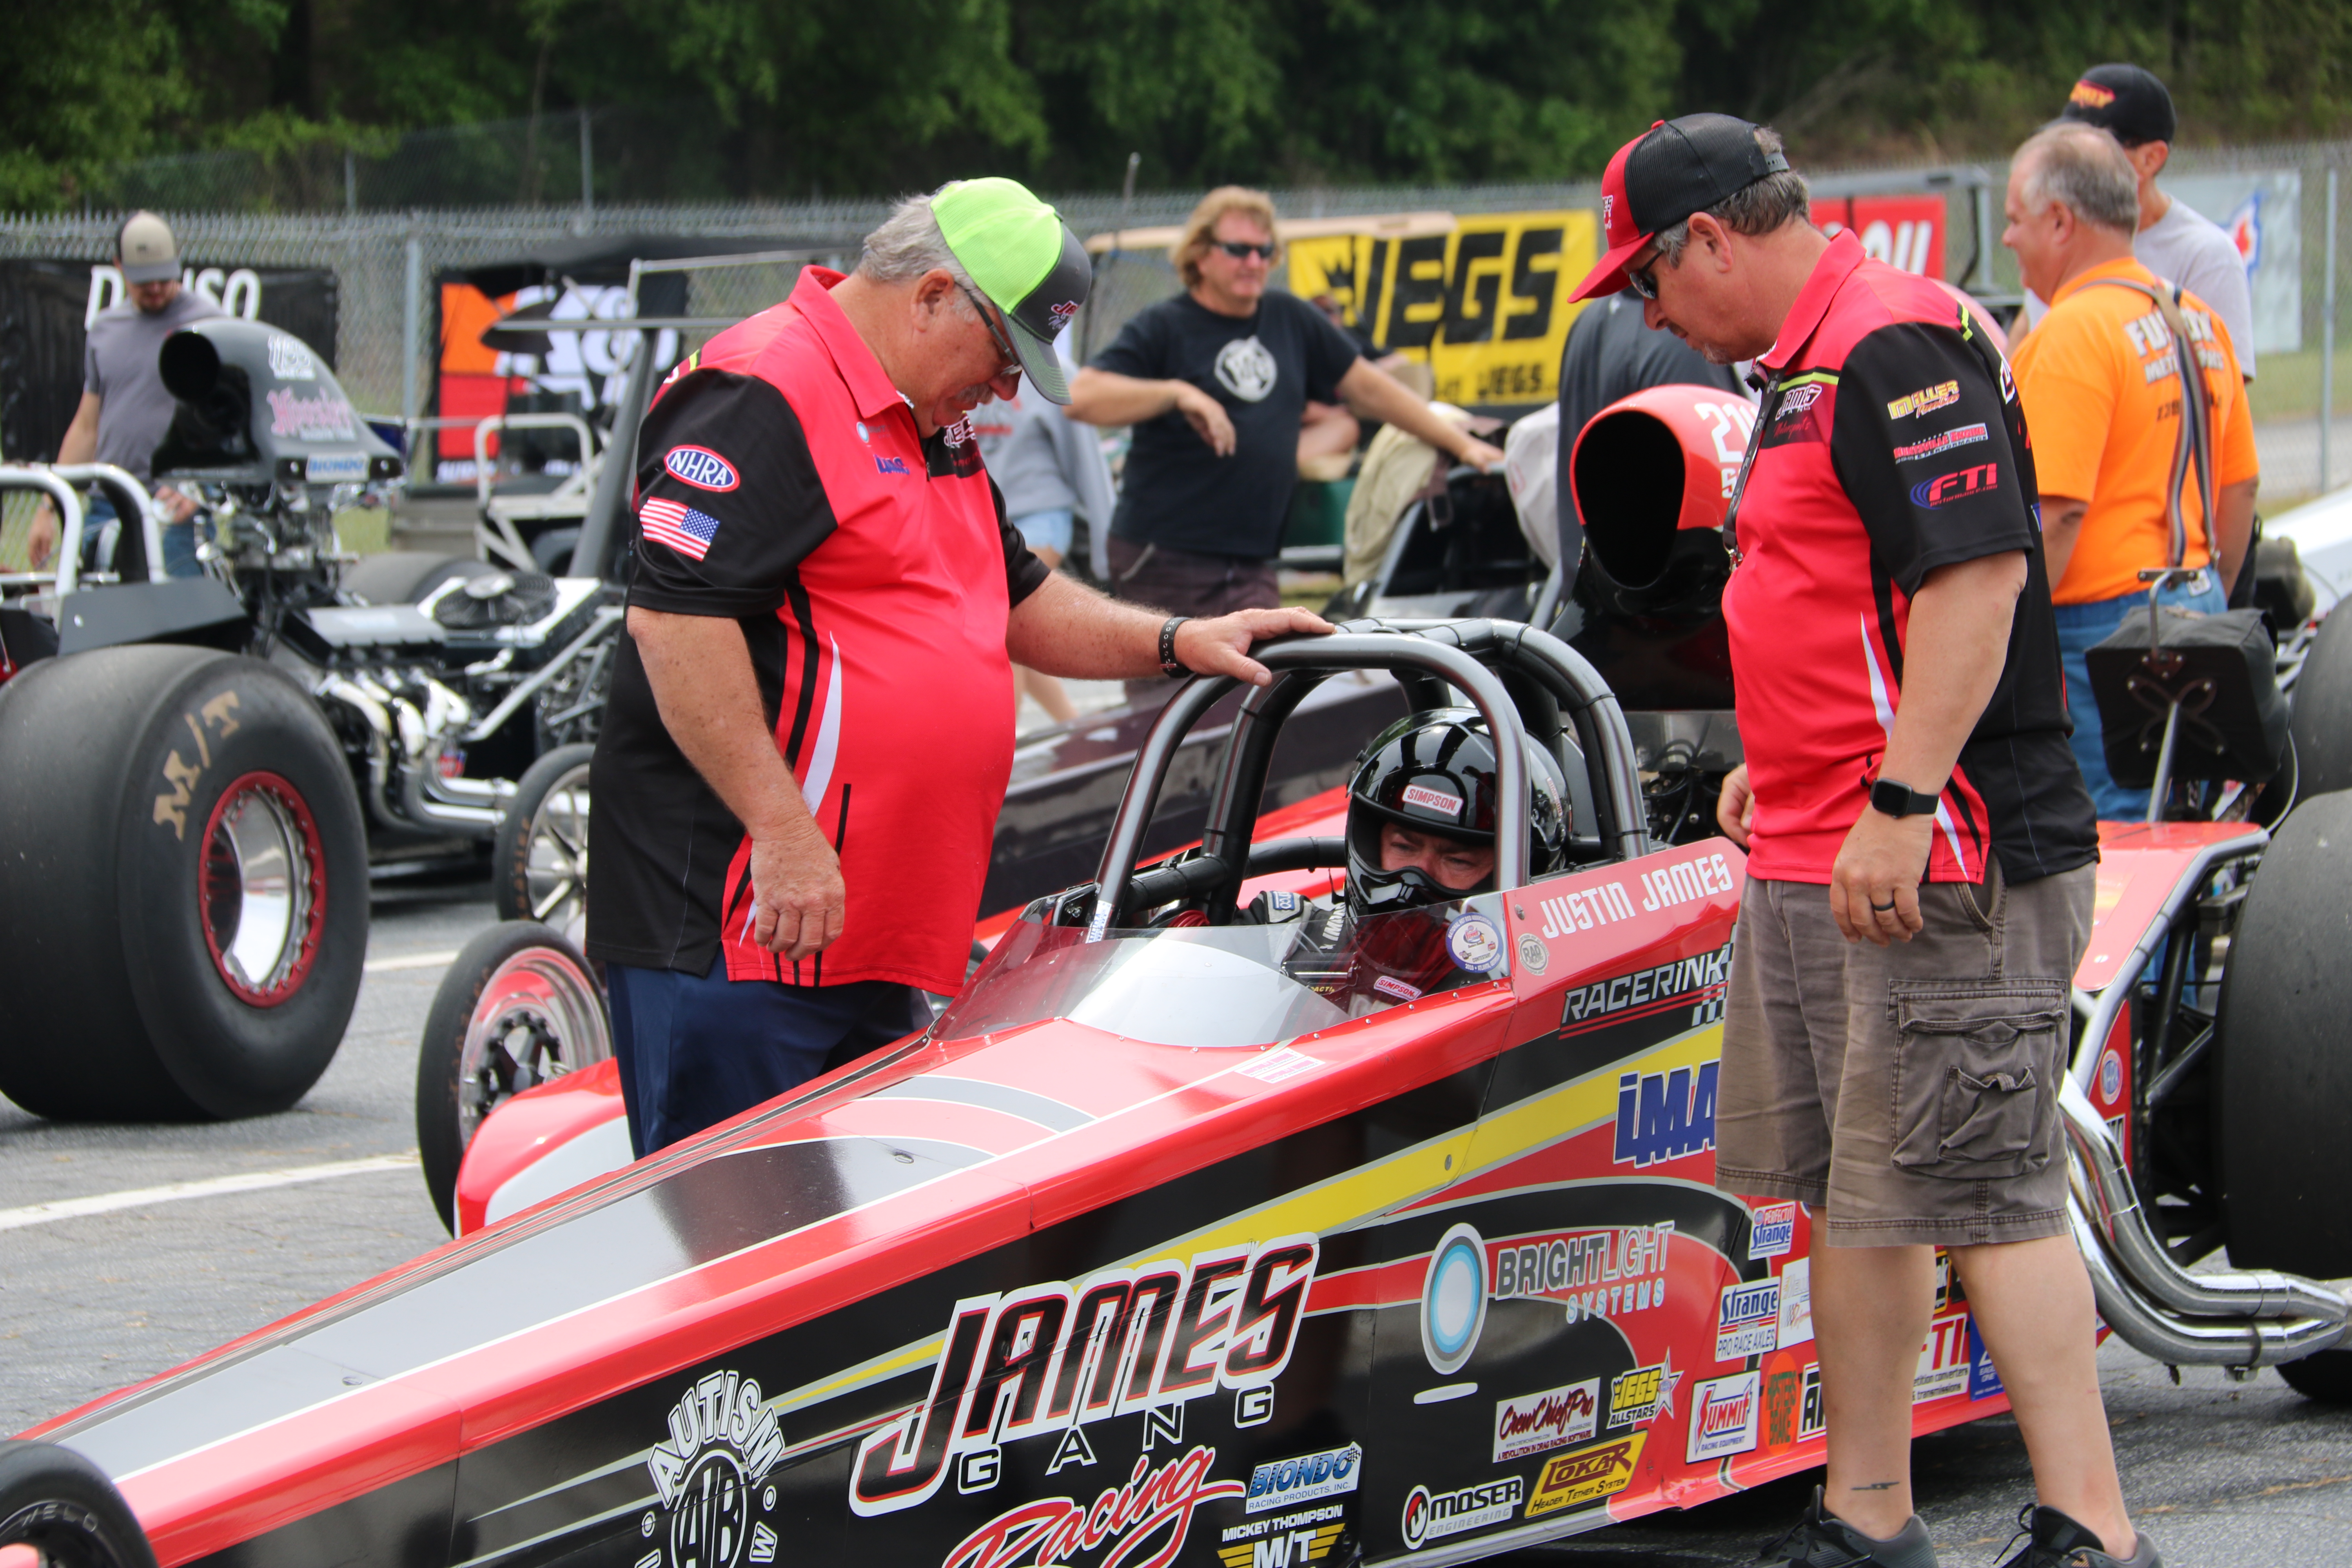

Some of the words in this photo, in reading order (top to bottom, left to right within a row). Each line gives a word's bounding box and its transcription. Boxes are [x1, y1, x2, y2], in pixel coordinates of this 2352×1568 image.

[84, 265, 261, 331] DSO
[1893, 434, 1949, 459] HUNTSVILLE
[1950, 426, 1985, 442] ENGINE
[670, 451, 728, 486] NHRA
[1929, 463, 1997, 502] FTI
[1930, 484, 1998, 507] performance.com
[153, 690, 240, 841] M/T
[1407, 789, 1457, 811] SIMPSON
[1540, 881, 1636, 939] JUSTIN
[1641, 853, 1734, 912] JAMES
[1378, 979, 1414, 997] SIMPSON
[1751, 1220, 1792, 1250] Strange
[1764, 1206, 1794, 1226] PERFECTLY
[1566, 1278, 1664, 1324] SYSTEMS
[1720, 1284, 1779, 1326] Strange
[1716, 1337, 1733, 1358] PRO
[1733, 1334, 1753, 1354] RACE
[1752, 1329, 1775, 1350] AXLES
[1922, 1318, 1965, 1371] TI
[849, 1232, 1320, 1517] JAMES
[1612, 1368, 1661, 1410] JEGS
[1916, 1382, 1961, 1399] transmissions
[1935, 1367, 1968, 1382] converters
[1609, 1405, 1656, 1426] ALLSTARS
[648, 1369, 785, 1510] AUTISM
[958, 1381, 1275, 1494] GANG
[1497, 1452, 1502, 1461] A
[1501, 1447, 1531, 1460] REVOLUTION
[1531, 1445, 1536, 1454] IN
[1536, 1441, 1549, 1452] DRAG
[1550, 1437, 1568, 1448] RACING
[1568, 1430, 1592, 1444] SOFTWARE
[1701, 1440, 1718, 1451] RACING
[1719, 1435, 1746, 1448] EQUIPMENT
[1247, 1450, 1354, 1499] BIONDO
[1541, 1441, 1632, 1495] LOKAR
[940, 1445, 1246, 1568] Racing
[1249, 1497, 1281, 1510] RACING
[1284, 1486, 1332, 1502] PRODUCTS,
[1334, 1481, 1350, 1491] INC.
[1222, 1519, 1271, 1542] MICKEY
[1272, 1504, 1343, 1531] THOMPSON
[1428, 1507, 1510, 1535] ENGINEERING
[1253, 1529, 1317, 1568] M/T
